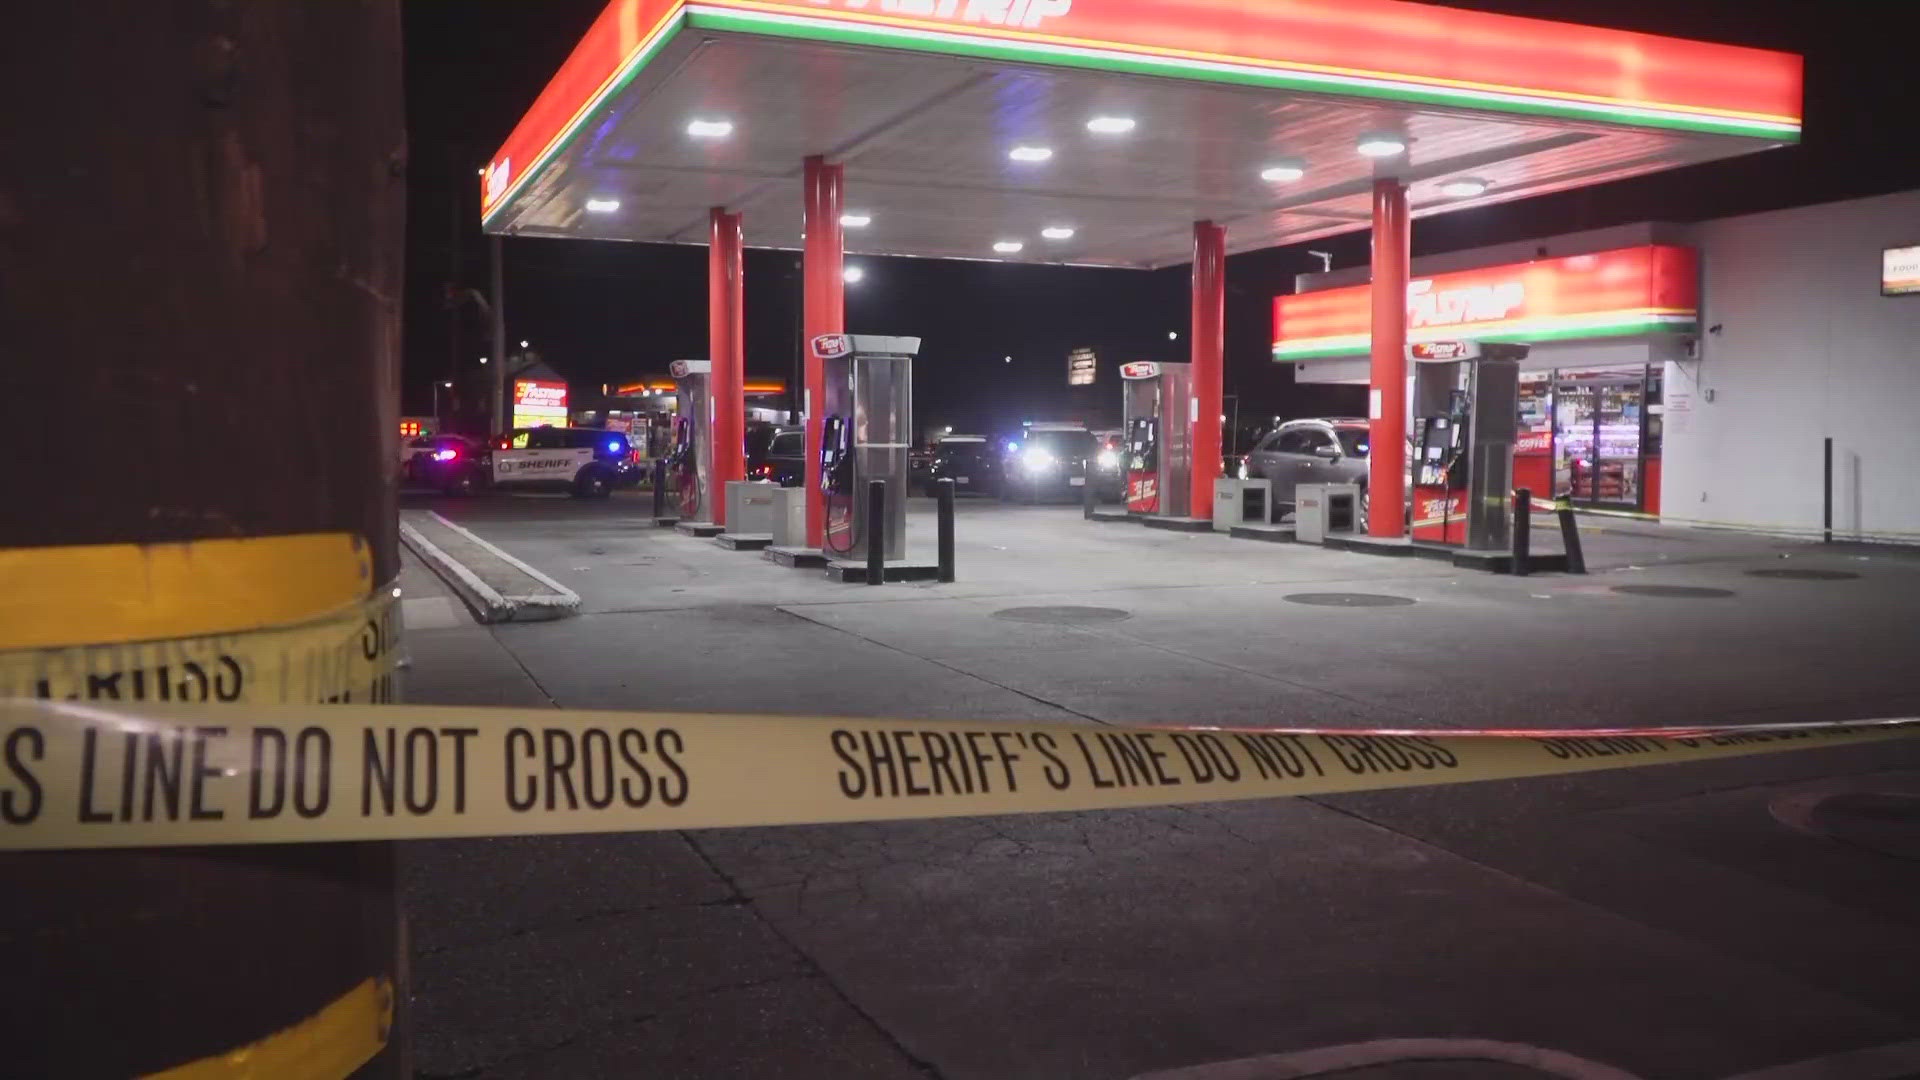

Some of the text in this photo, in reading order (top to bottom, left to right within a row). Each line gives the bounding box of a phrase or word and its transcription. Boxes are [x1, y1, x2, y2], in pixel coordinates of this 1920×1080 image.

[519, 460, 572, 469] SHERIFF
[78, 727, 228, 824] LINE
[248, 726, 331, 819] DO
[361, 726, 479, 817] NOT
[504, 727, 689, 812] CROSS
[831, 729, 1459, 800] SHERIFF'S LINE DO NOT CROSS
